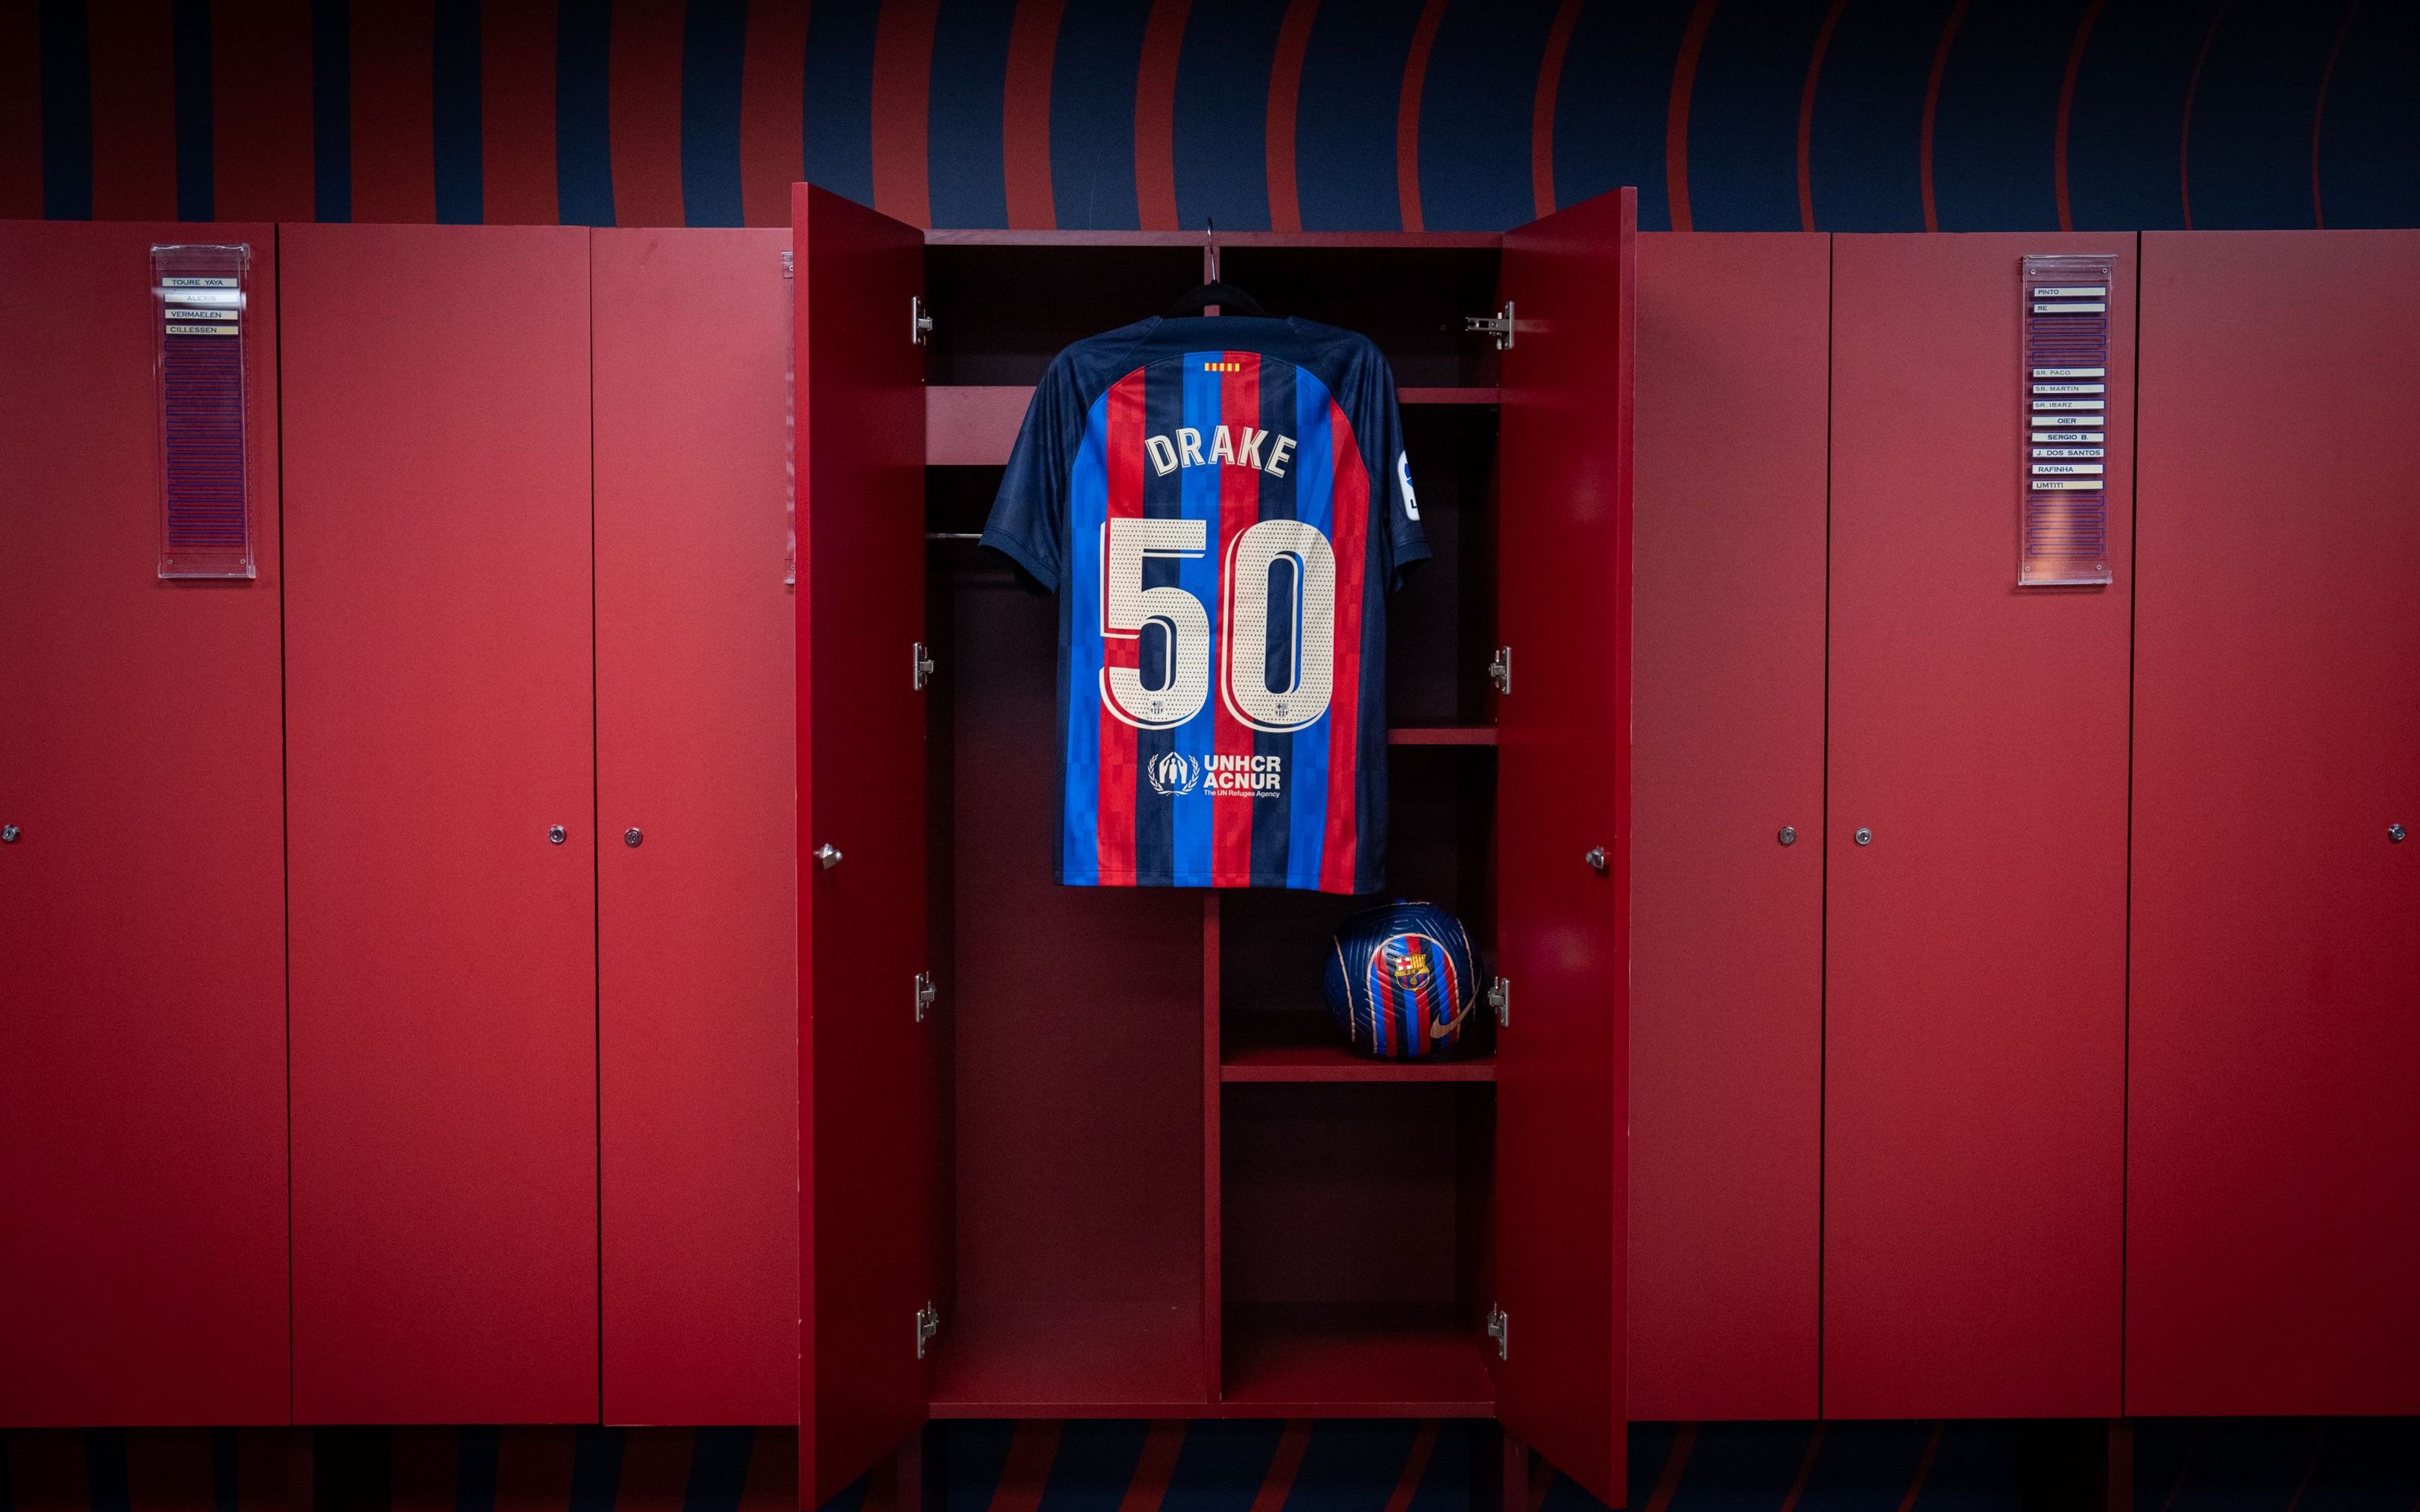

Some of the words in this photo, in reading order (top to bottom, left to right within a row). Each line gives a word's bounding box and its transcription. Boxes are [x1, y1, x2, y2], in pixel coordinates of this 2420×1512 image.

[1144, 425, 1298, 479] DRAKE
[1099, 517, 1336, 733] 50
[1203, 754, 1281, 772] UNHCR
[1202, 772, 1281, 789] ACNUR
[1228, 789, 1255, 798] Refugee
[1255, 790, 1280, 798] Agency
